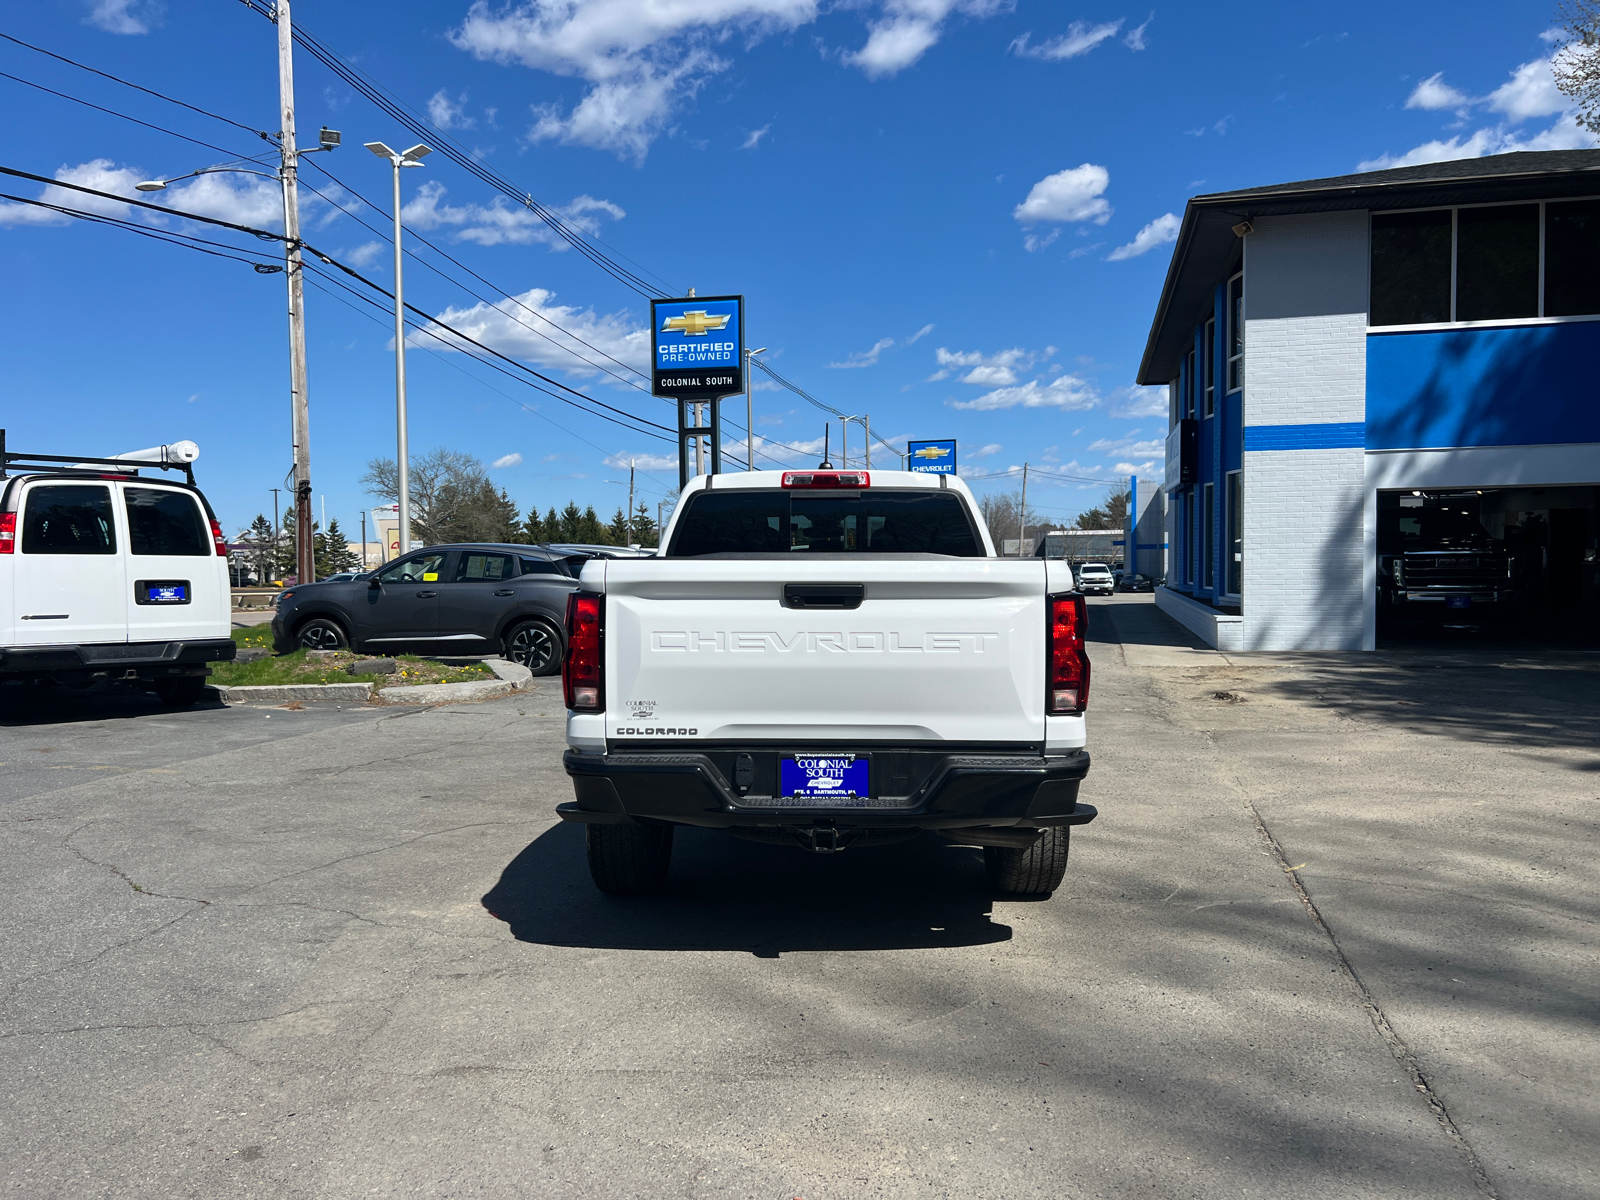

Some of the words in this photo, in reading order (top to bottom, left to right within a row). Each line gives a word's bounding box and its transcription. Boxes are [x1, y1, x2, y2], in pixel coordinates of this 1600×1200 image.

[659, 342, 734, 353] CERTIFIED
[662, 352, 731, 362] PRE-OWNED
[661, 378, 702, 387] COLONIAL
[706, 377, 733, 385] SOUTH
[651, 631, 999, 653] CHEVROLET
[798, 759, 852, 768] COLONIAL
[806, 769, 844, 777] SOUTH
